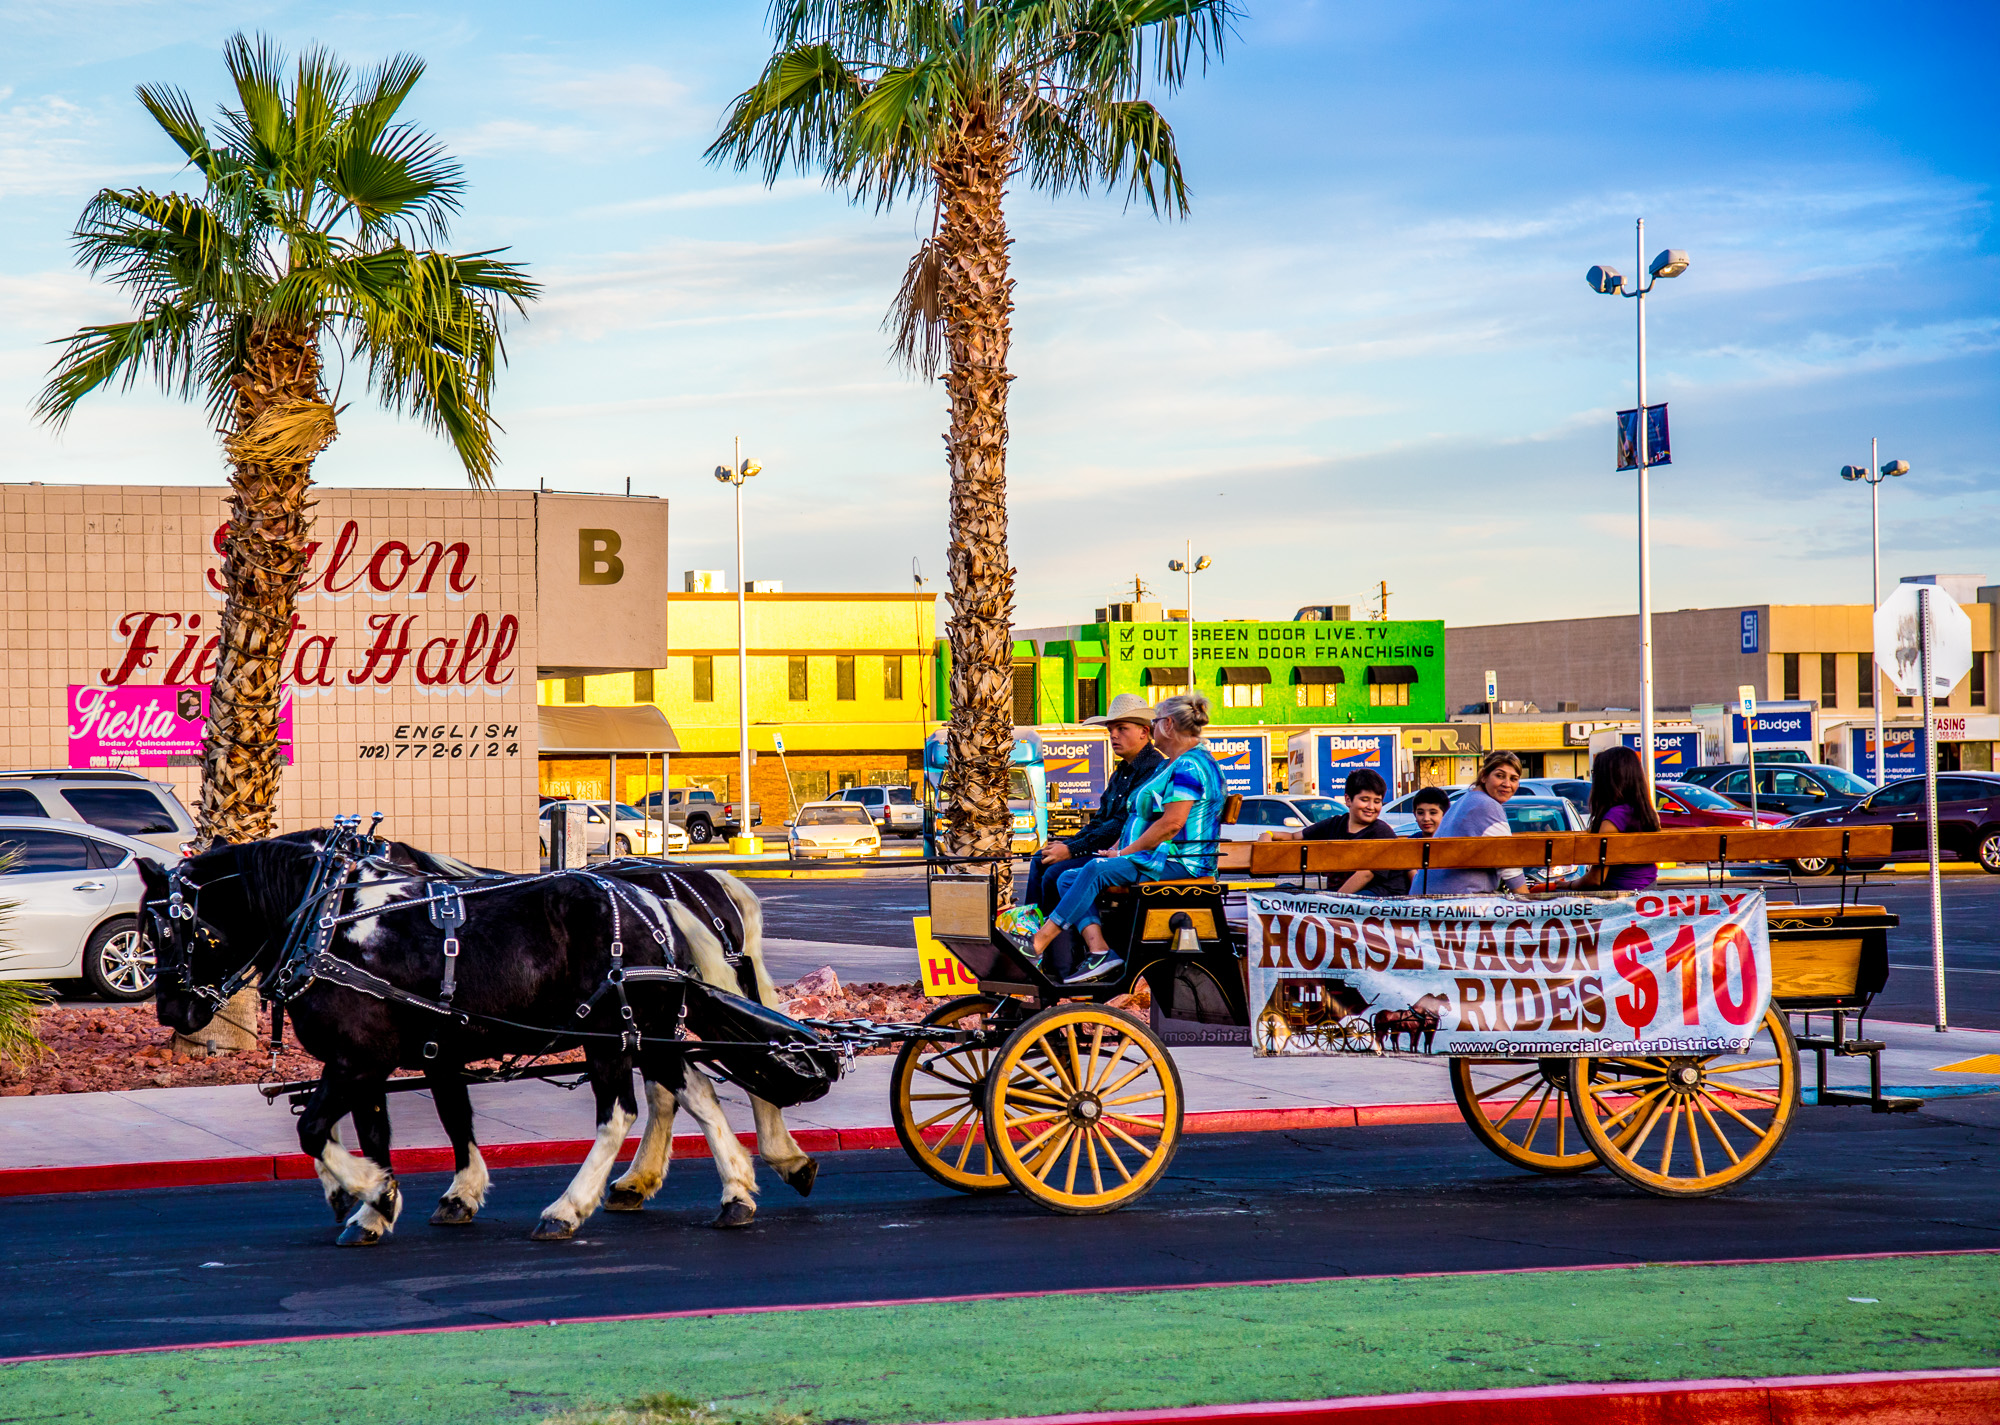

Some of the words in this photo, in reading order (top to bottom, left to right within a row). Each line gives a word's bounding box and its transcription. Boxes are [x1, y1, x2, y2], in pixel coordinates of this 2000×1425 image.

[208, 520, 477, 594] lon
[578, 528, 625, 586] B
[1143, 629, 1178, 642] OUT
[1191, 628, 1248, 641] GREEN
[1258, 628, 1306, 641] DOOR
[1315, 627, 1388, 640] LIVE.TV
[101, 611, 339, 686] Fieta
[348, 613, 519, 686] Hall
[1143, 648, 1177, 661] OUT
[1192, 647, 1249, 660] GREEN
[1258, 647, 1306, 659] DOOR
[1316, 645, 1435, 659] FRANCHISING
[68, 685, 175, 740] Fiesta
[394, 724, 518, 739] ENGLISH
[1759, 718, 1801, 732] Budget
[1933, 718, 1966, 730] ASING
[1330, 736, 1380, 752] Budget
[1633, 736, 1682, 750] Bdget
[1866, 728, 1915, 744] Bdget
[111, 748, 138, 756] Sweet
[140, 748, 173, 756] Sixteen
[359, 743, 390, 760] 702)
[1042, 744, 1089, 759] Budget
[1458, 742, 1470, 750] TM
[1260, 898, 1365, 916] COMMERCIAL
[1369, 905, 1432, 918] CENTER
[1436, 905, 1489, 918] FAMILY
[1493, 904, 1536, 918] OPEN
[1540, 903, 1593, 917] HOUSE
[1635, 893, 1747, 918] ONLY
[1257, 914, 1424, 973] HORSE
[1428, 917, 1604, 974] WAGON
[1612, 920, 1759, 1041] $10
[1454, 975, 1607, 1034] RIDES
